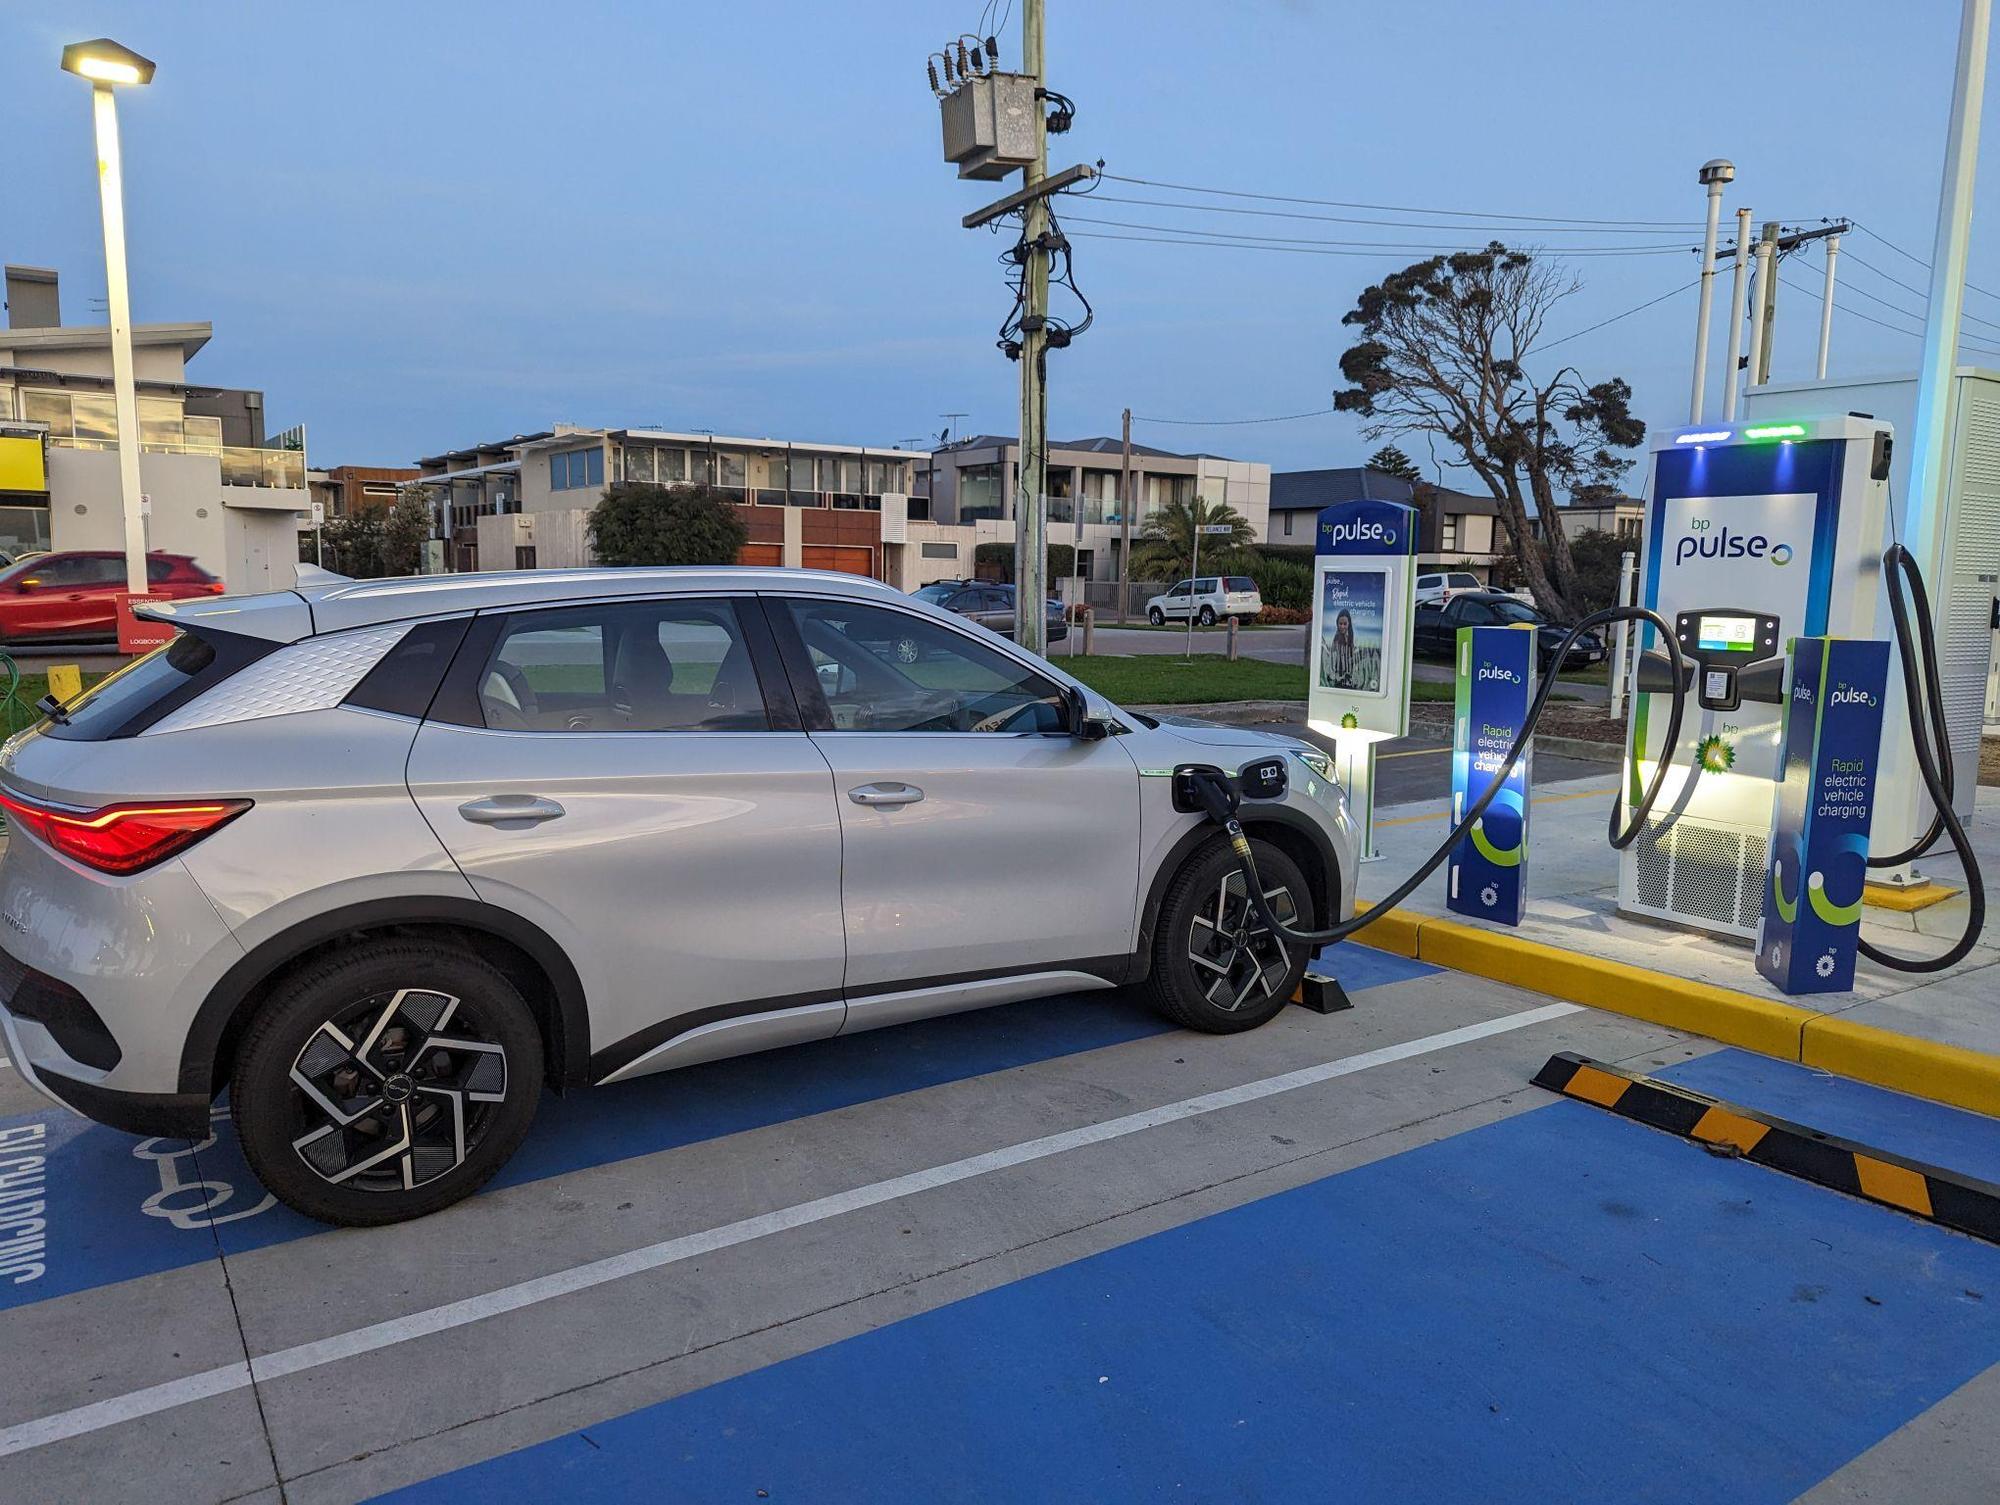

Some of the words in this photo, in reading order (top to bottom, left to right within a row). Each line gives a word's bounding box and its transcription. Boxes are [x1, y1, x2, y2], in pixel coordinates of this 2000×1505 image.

[1691, 516, 1710, 532] bp
[1322, 523, 1333, 534] bp
[1332, 517, 1383, 546] pulse
[1676, 526, 1768, 566] pulse
[1332, 586, 1349, 600] Rapid
[1355, 600, 1376, 608] vehicle
[1350, 608, 1376, 617] charging
[1478, 666, 1512, 681] pulse
[1793, 683, 1811, 702] pulse
[1838, 682, 1847, 690] bp
[1831, 687, 1868, 707] pulse
[1482, 724, 1512, 738] Rapid
[1722, 721, 1739, 735] bp
[1478, 749, 1508, 762] vehicl
[1831, 758, 1863, 776] Rapid
[1824, 775, 1867, 788] electric
[1824, 789, 1864, 802] vehicle
[1818, 804, 1867, 818] charging
[1828, 947, 1837, 955] bp
